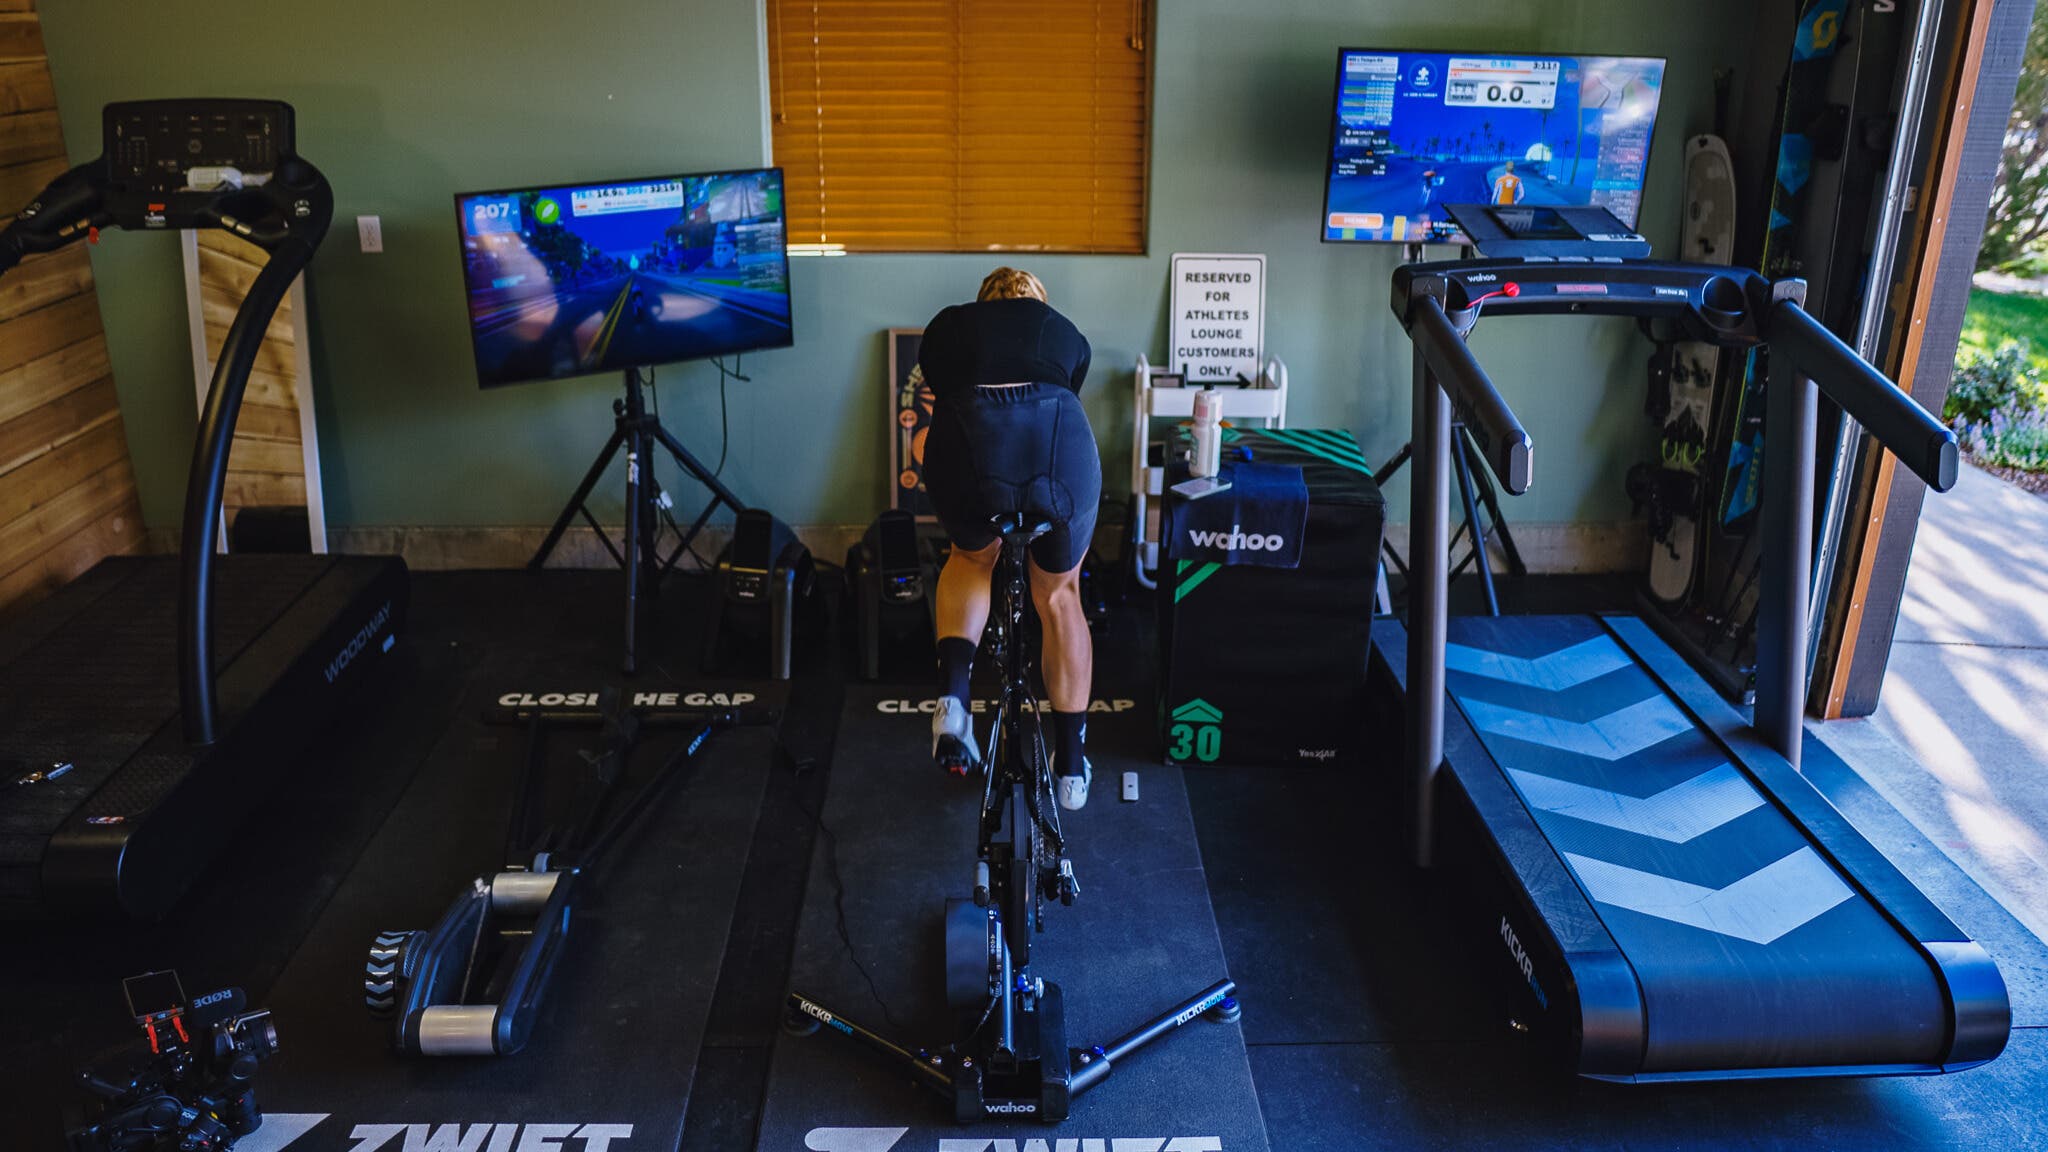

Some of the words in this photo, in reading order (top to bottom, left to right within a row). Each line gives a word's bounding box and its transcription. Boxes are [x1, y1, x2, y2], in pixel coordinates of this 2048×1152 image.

[1486, 85, 1524, 103] 0.0
[474, 202, 510, 219] 207
[1185, 272, 1252, 283] RESERVED
[1467, 273, 1497, 283] wahoo
[1205, 291, 1231, 302] FOR
[1185, 310, 1250, 321] ATHLETES
[1191, 329, 1243, 339] LOUNGE
[1178, 347, 1255, 358] CUSTOMERS
[1199, 366, 1233, 376] ONLY
[1189, 524, 1284, 551] wahoo
[324, 600, 393, 684] WOODWAY
[633, 692, 680, 707] HE
[684, 692, 756, 707] GAP
[876, 699, 986, 713] CLOE
[1169, 723, 1222, 762] 30
[1500, 915, 1533, 983] KICKR
[800, 998, 834, 1025] KICKR
[1175, 1001, 1207, 1026] KICKR
[985, 1101, 1036, 1113] wahoo
